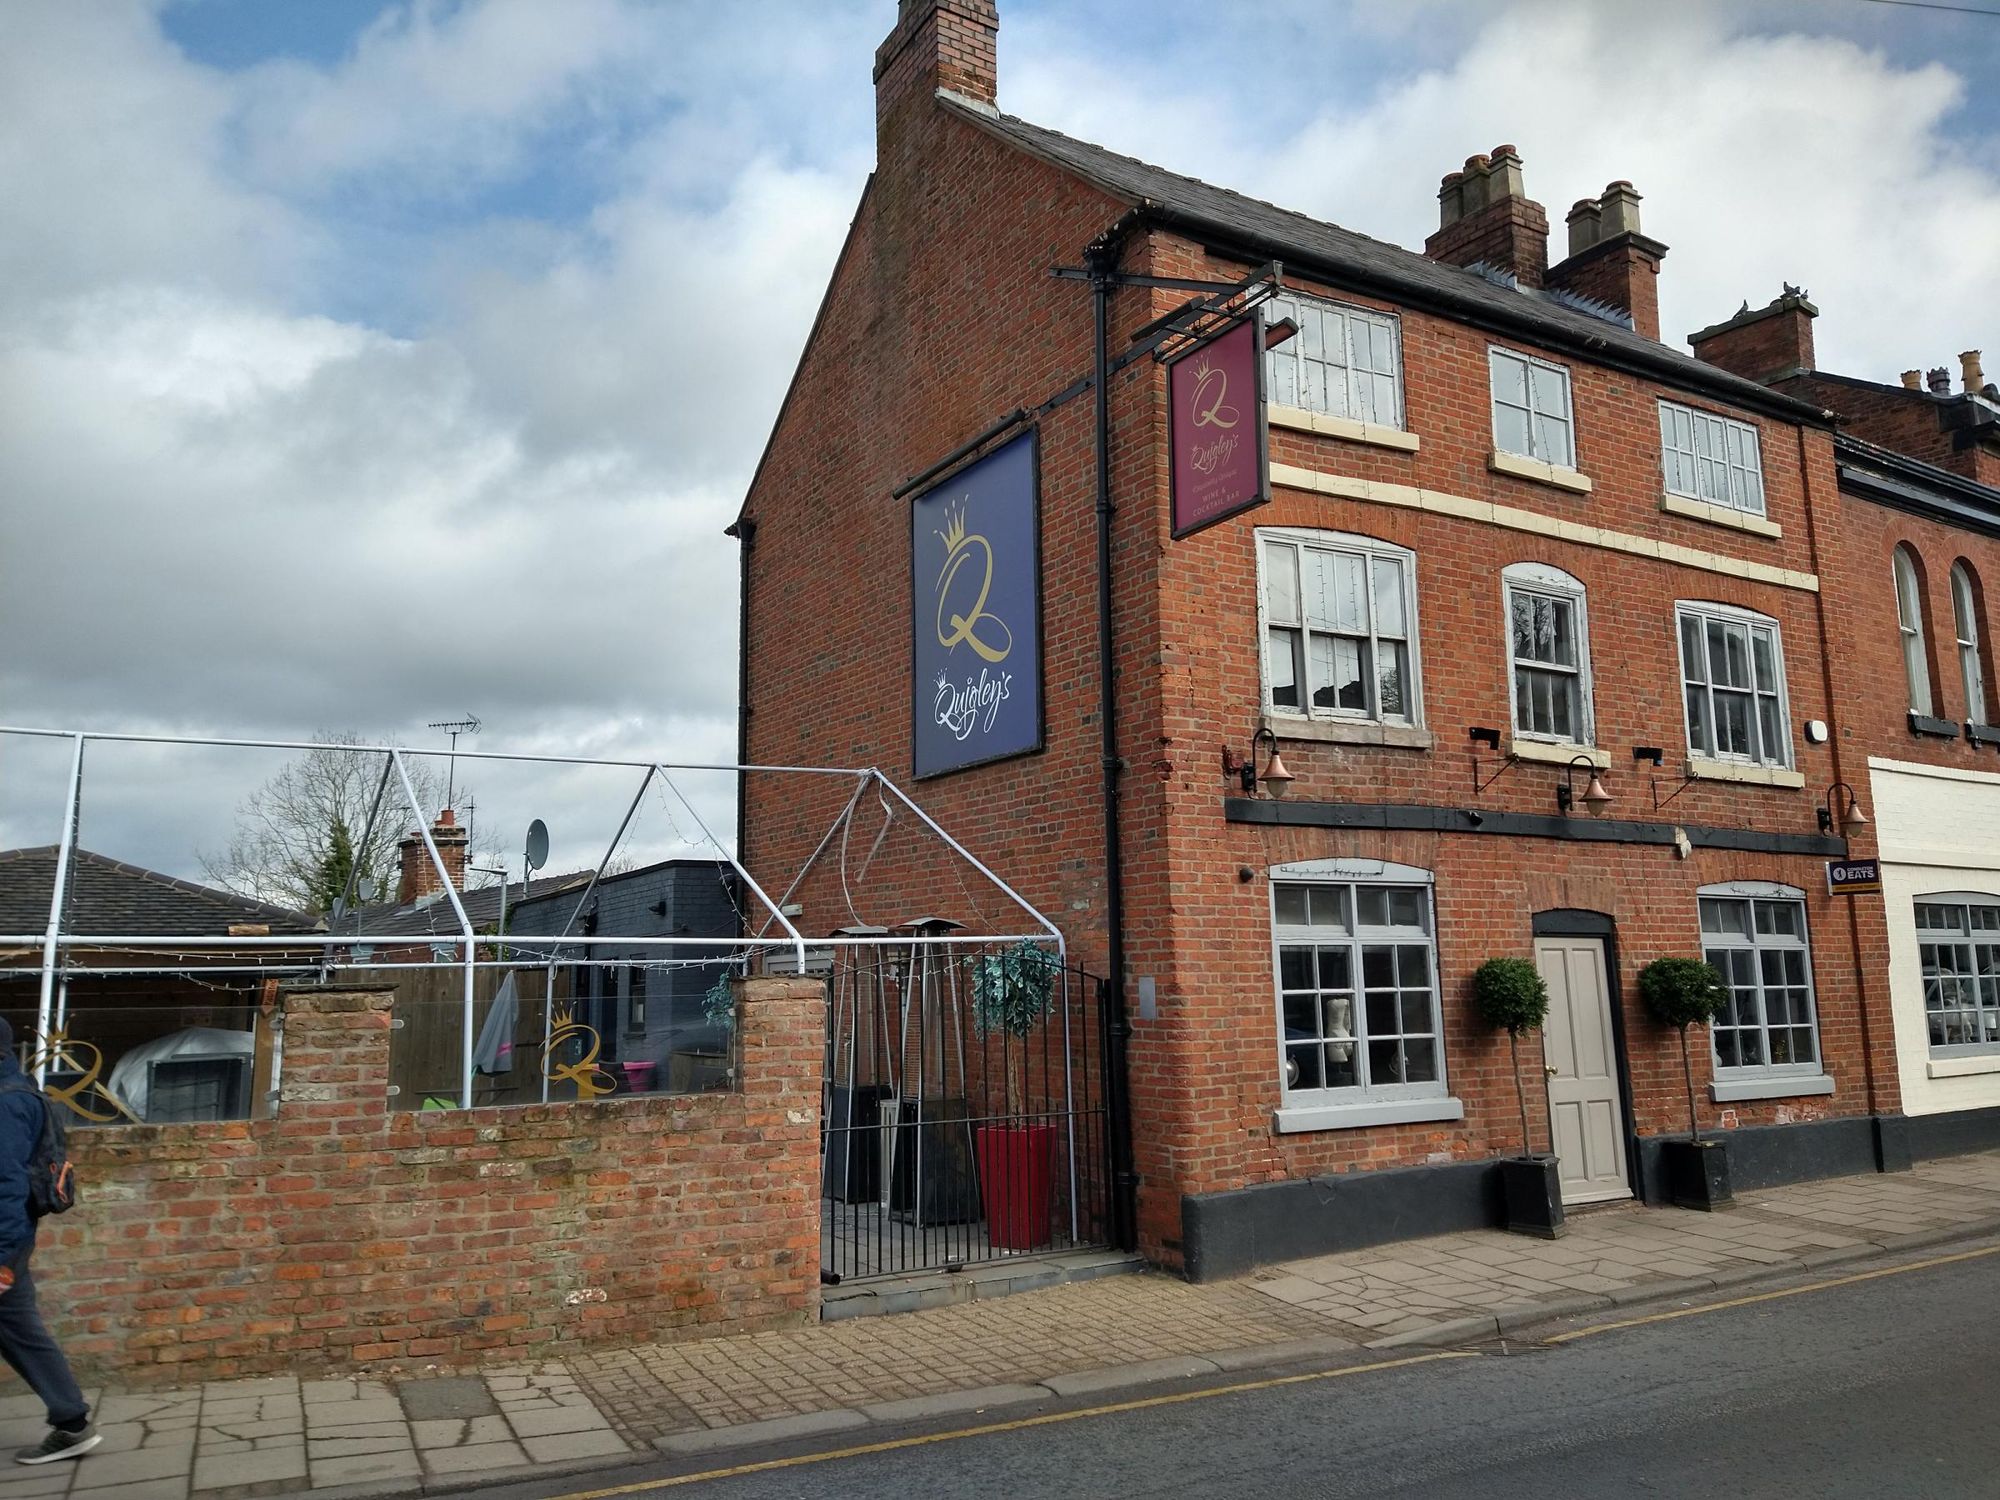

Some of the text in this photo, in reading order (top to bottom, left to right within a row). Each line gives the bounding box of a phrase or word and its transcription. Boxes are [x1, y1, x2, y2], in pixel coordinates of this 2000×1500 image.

[1191, 368, 1240, 429] Q
[1191, 433, 1239, 474] Quigley's
[1192, 497, 1223, 516] COCKTAIL
[934, 534, 1012, 663] Q
[934, 667, 1012, 741] Quigley's
[1847, 870, 1874, 879] EATS
